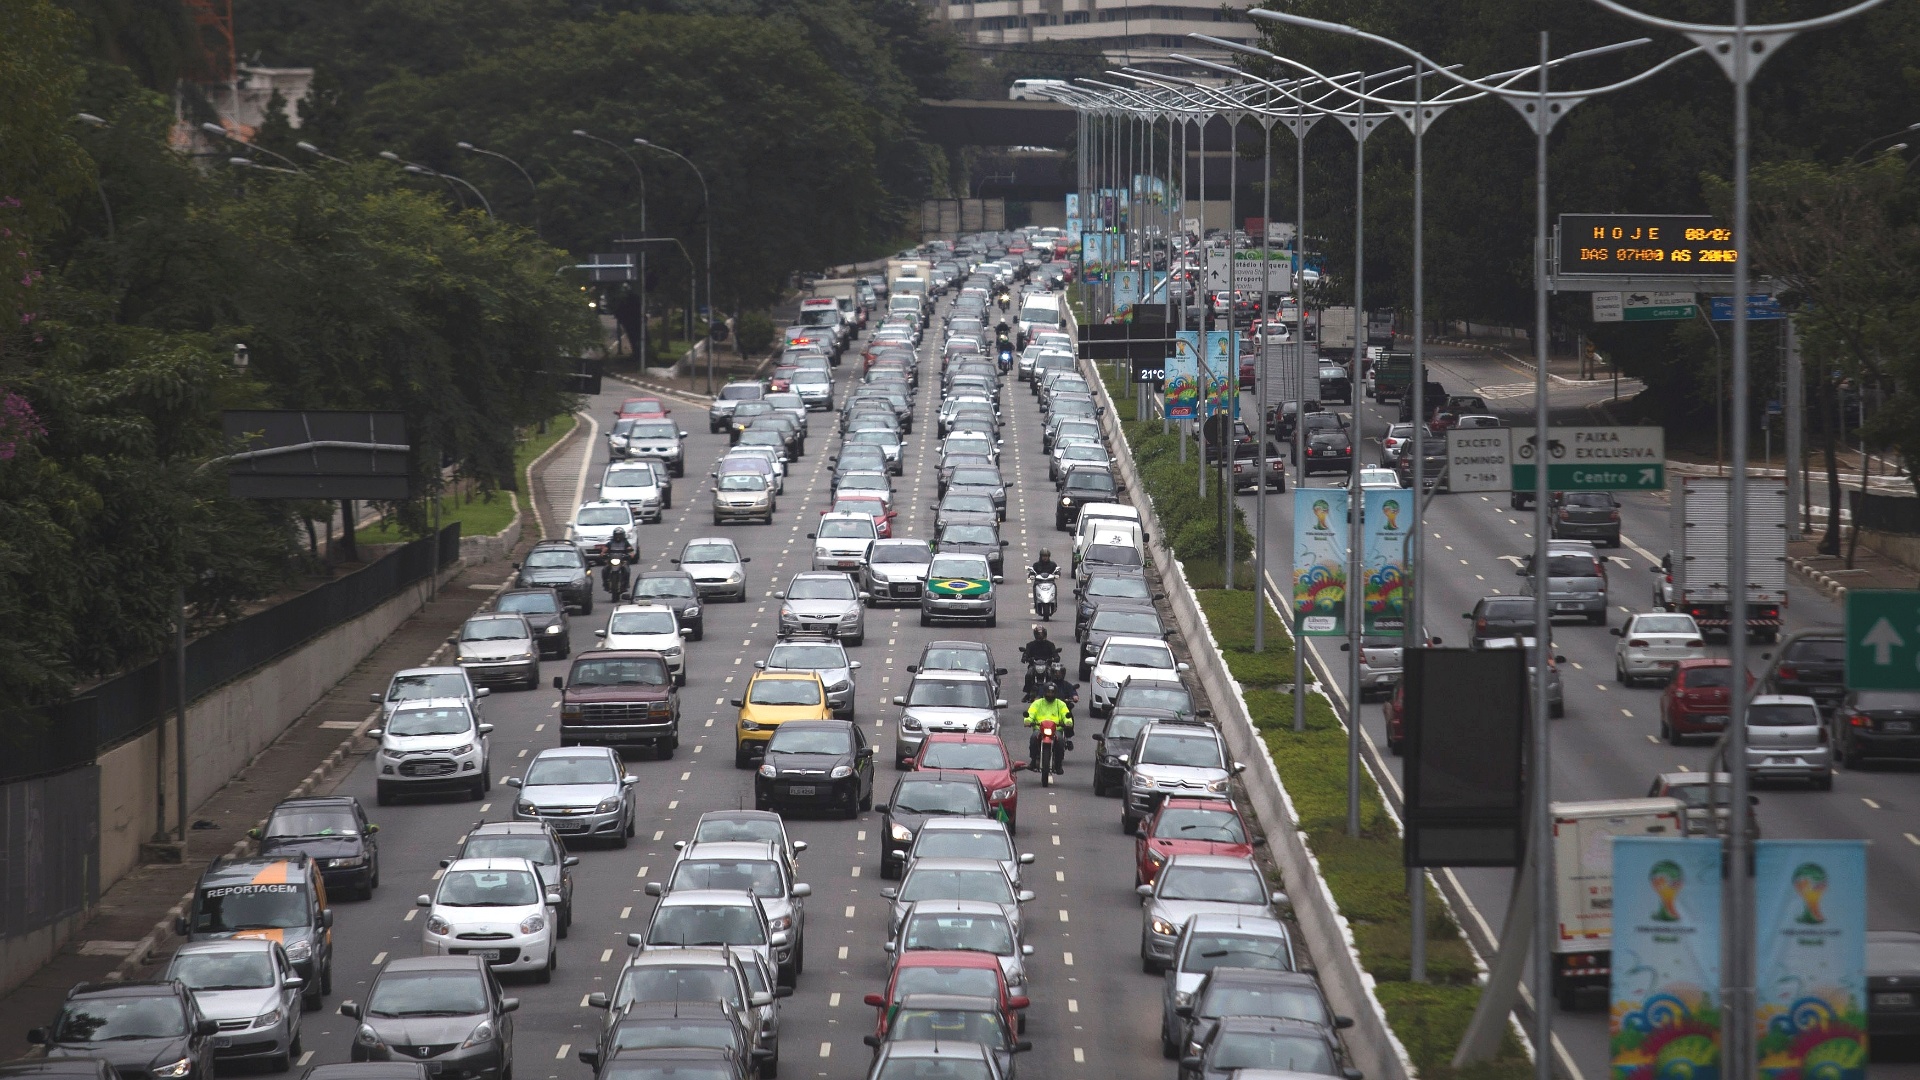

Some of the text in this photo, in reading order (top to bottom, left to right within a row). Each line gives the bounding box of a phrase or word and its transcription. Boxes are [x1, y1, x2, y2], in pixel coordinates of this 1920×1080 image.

[1580, 248, 1608, 260] DAS
[1616, 248, 1664, 261] 07H00
[1671, 249, 1692, 261] AS
[1141, 369, 1165, 380] 21°C
[1576, 432, 1620, 442] FAIXA
[1457, 438, 1502, 448] EXCETO
[1576, 447, 1656, 458] EXCLUSIVA
[1454, 455, 1505, 465] DOMINGO
[1572, 470, 1628, 483] Centro
[207, 884, 297, 898] REPORTAGEM
